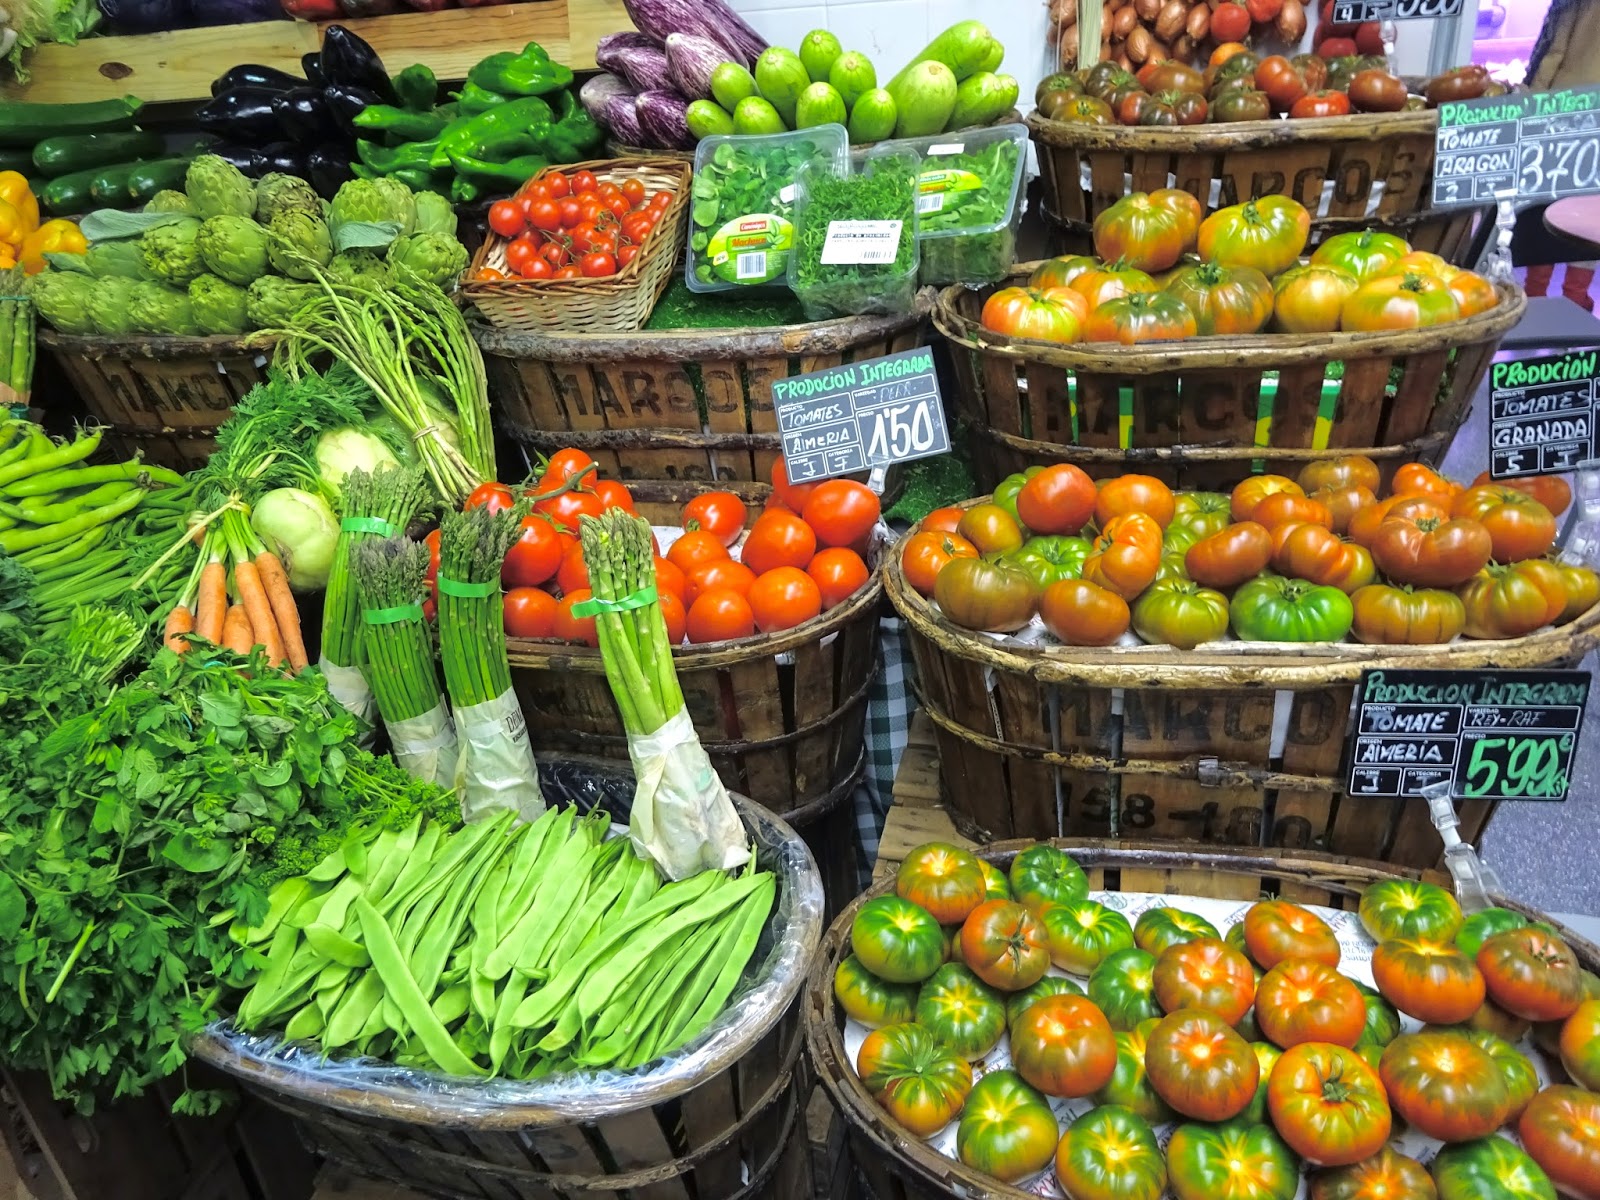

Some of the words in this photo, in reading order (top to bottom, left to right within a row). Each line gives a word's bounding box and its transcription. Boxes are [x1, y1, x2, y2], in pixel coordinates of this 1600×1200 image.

[1438, 128, 1501, 150] TOMATE
[1439, 149, 1513, 177] ARAGON
[860, 354, 933, 386] INTEGRADA
[781, 403, 843, 428] TOMATES
[1495, 389, 1592, 416] TOMATES
[1495, 418, 1587, 446] GRANADA
[1505, 455, 1524, 473] 5
[1366, 711, 1450, 732] TOMATE
